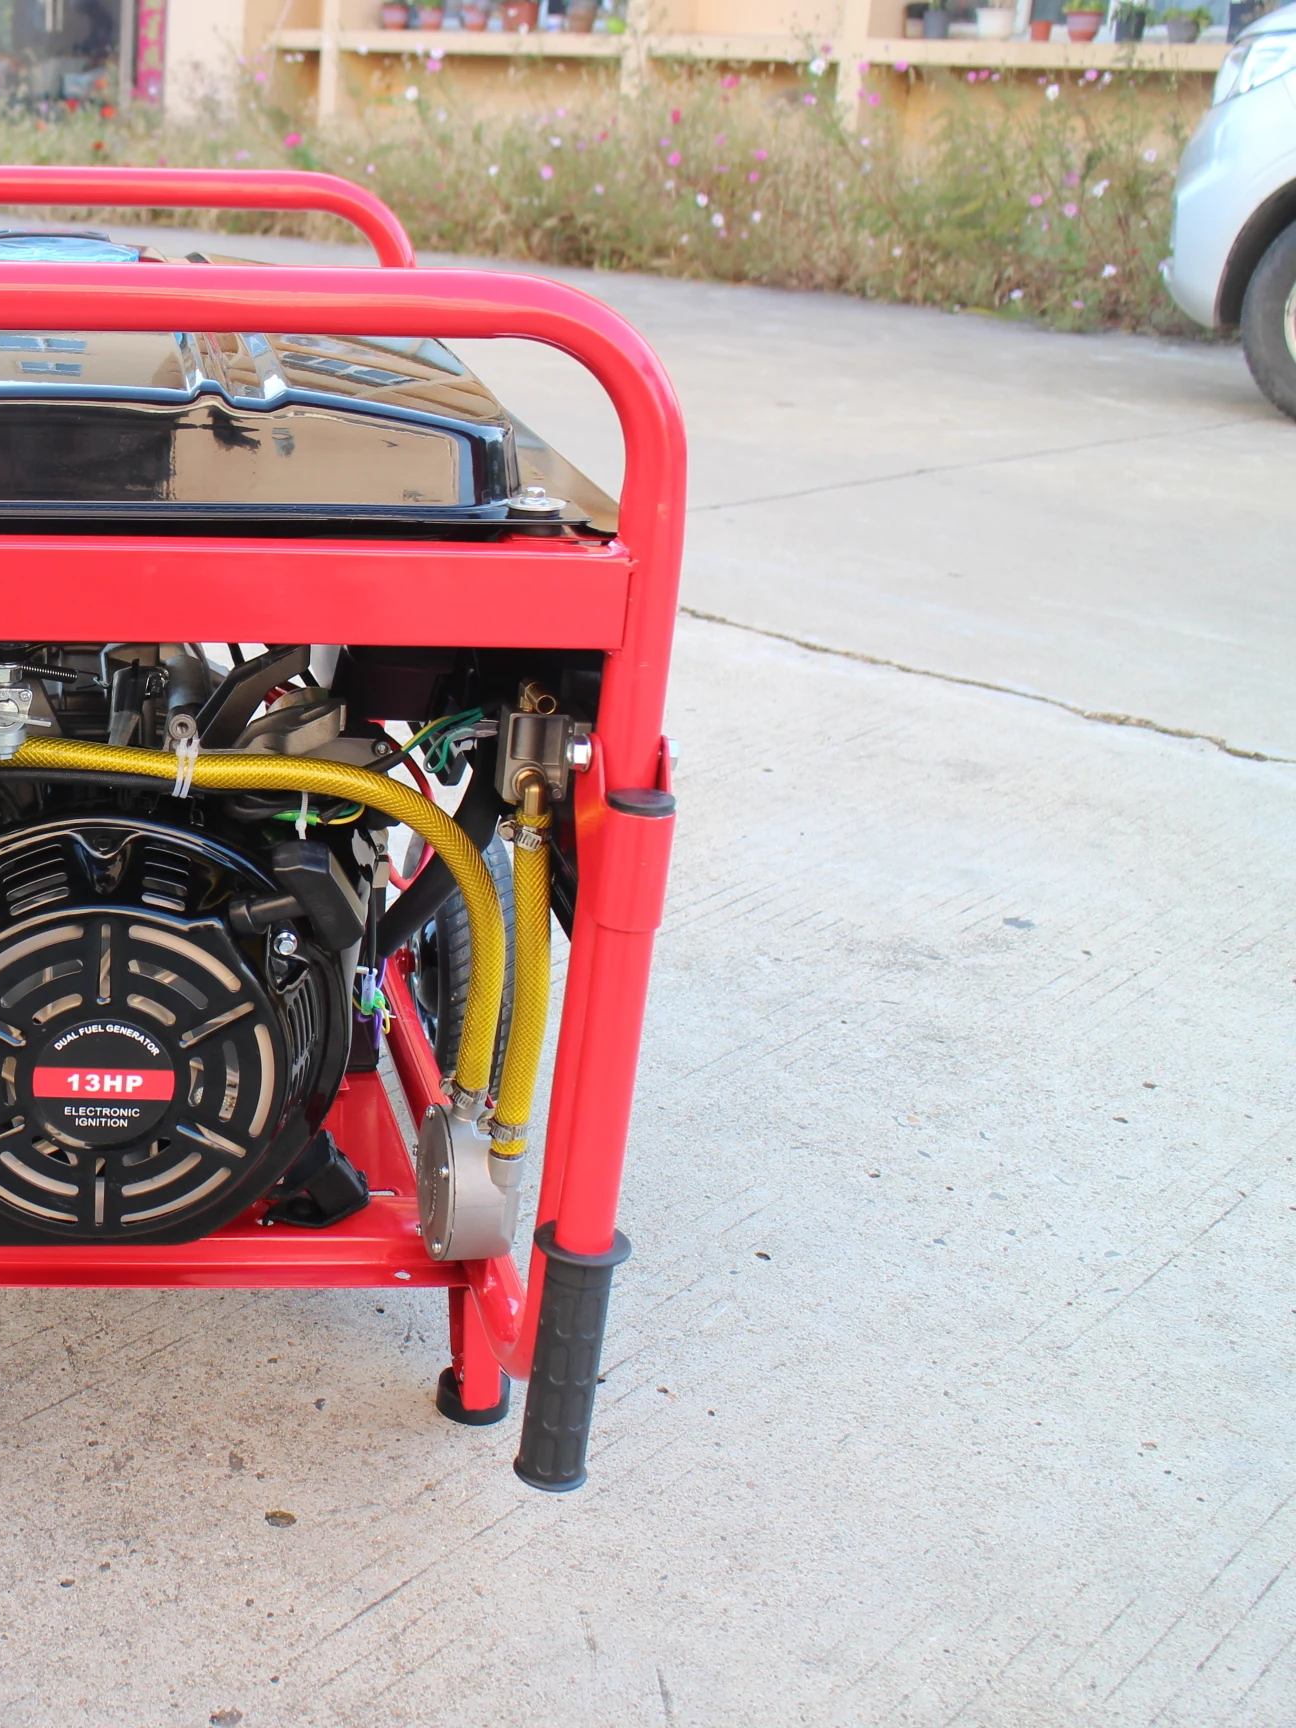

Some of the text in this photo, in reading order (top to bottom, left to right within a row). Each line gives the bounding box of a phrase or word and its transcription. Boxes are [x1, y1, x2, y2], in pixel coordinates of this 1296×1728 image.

[54, 1024, 160, 1056] DUAL FUEL GENERATOR
[67, 1073, 143, 1093] 13HP
[64, 1107, 140, 1117] ELECTRONIC
[75, 1117, 128, 1128] IGNITION
